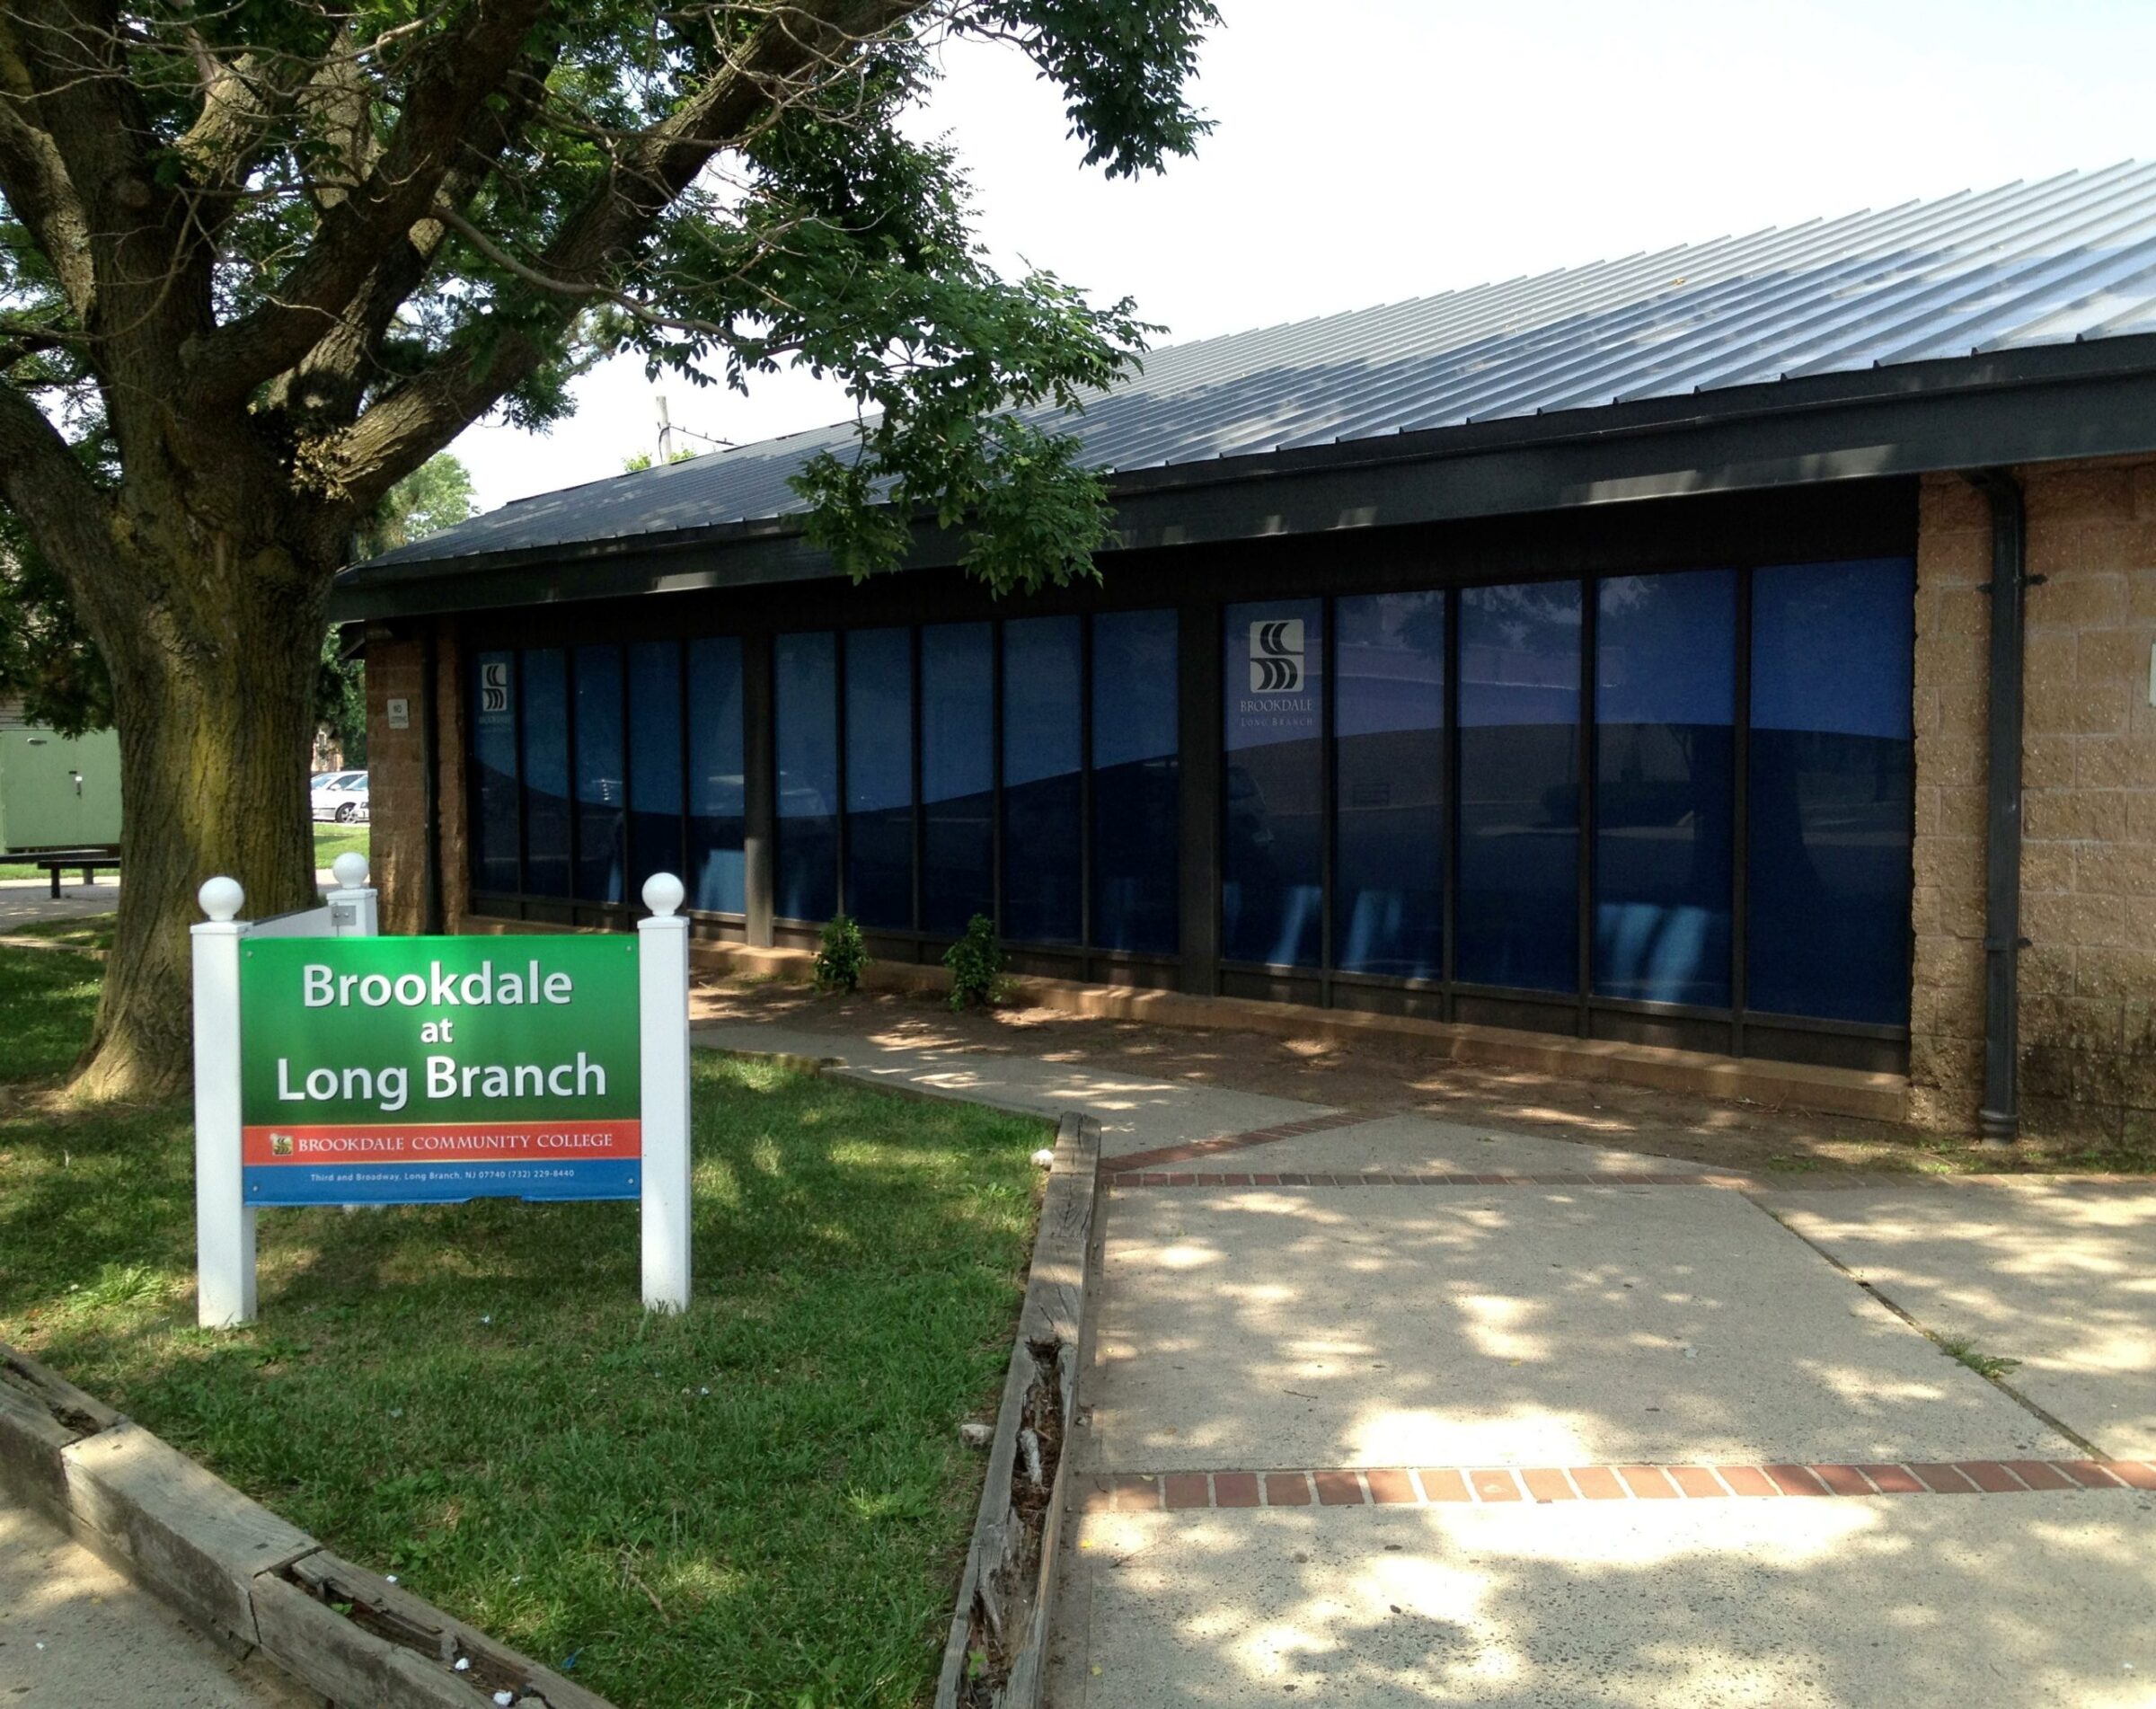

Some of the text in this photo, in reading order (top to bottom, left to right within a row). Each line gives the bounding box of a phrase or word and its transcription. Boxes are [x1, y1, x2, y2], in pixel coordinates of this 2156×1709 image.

[1241, 699, 1312, 713] BROOKDALE
[1272, 717, 1312, 727] BRANCH
[304, 960, 574, 1008] Brookdale
[420, 1018, 455, 1044] at
[278, 1052, 607, 1111] Long Branch
[298, 1133, 613, 1152] BROOKDALE COMMUNITY COLLEGE
[310, 1169, 575, 1182] Third and Broadway, Long Branch, NJ 07740 (732) 229-8440
